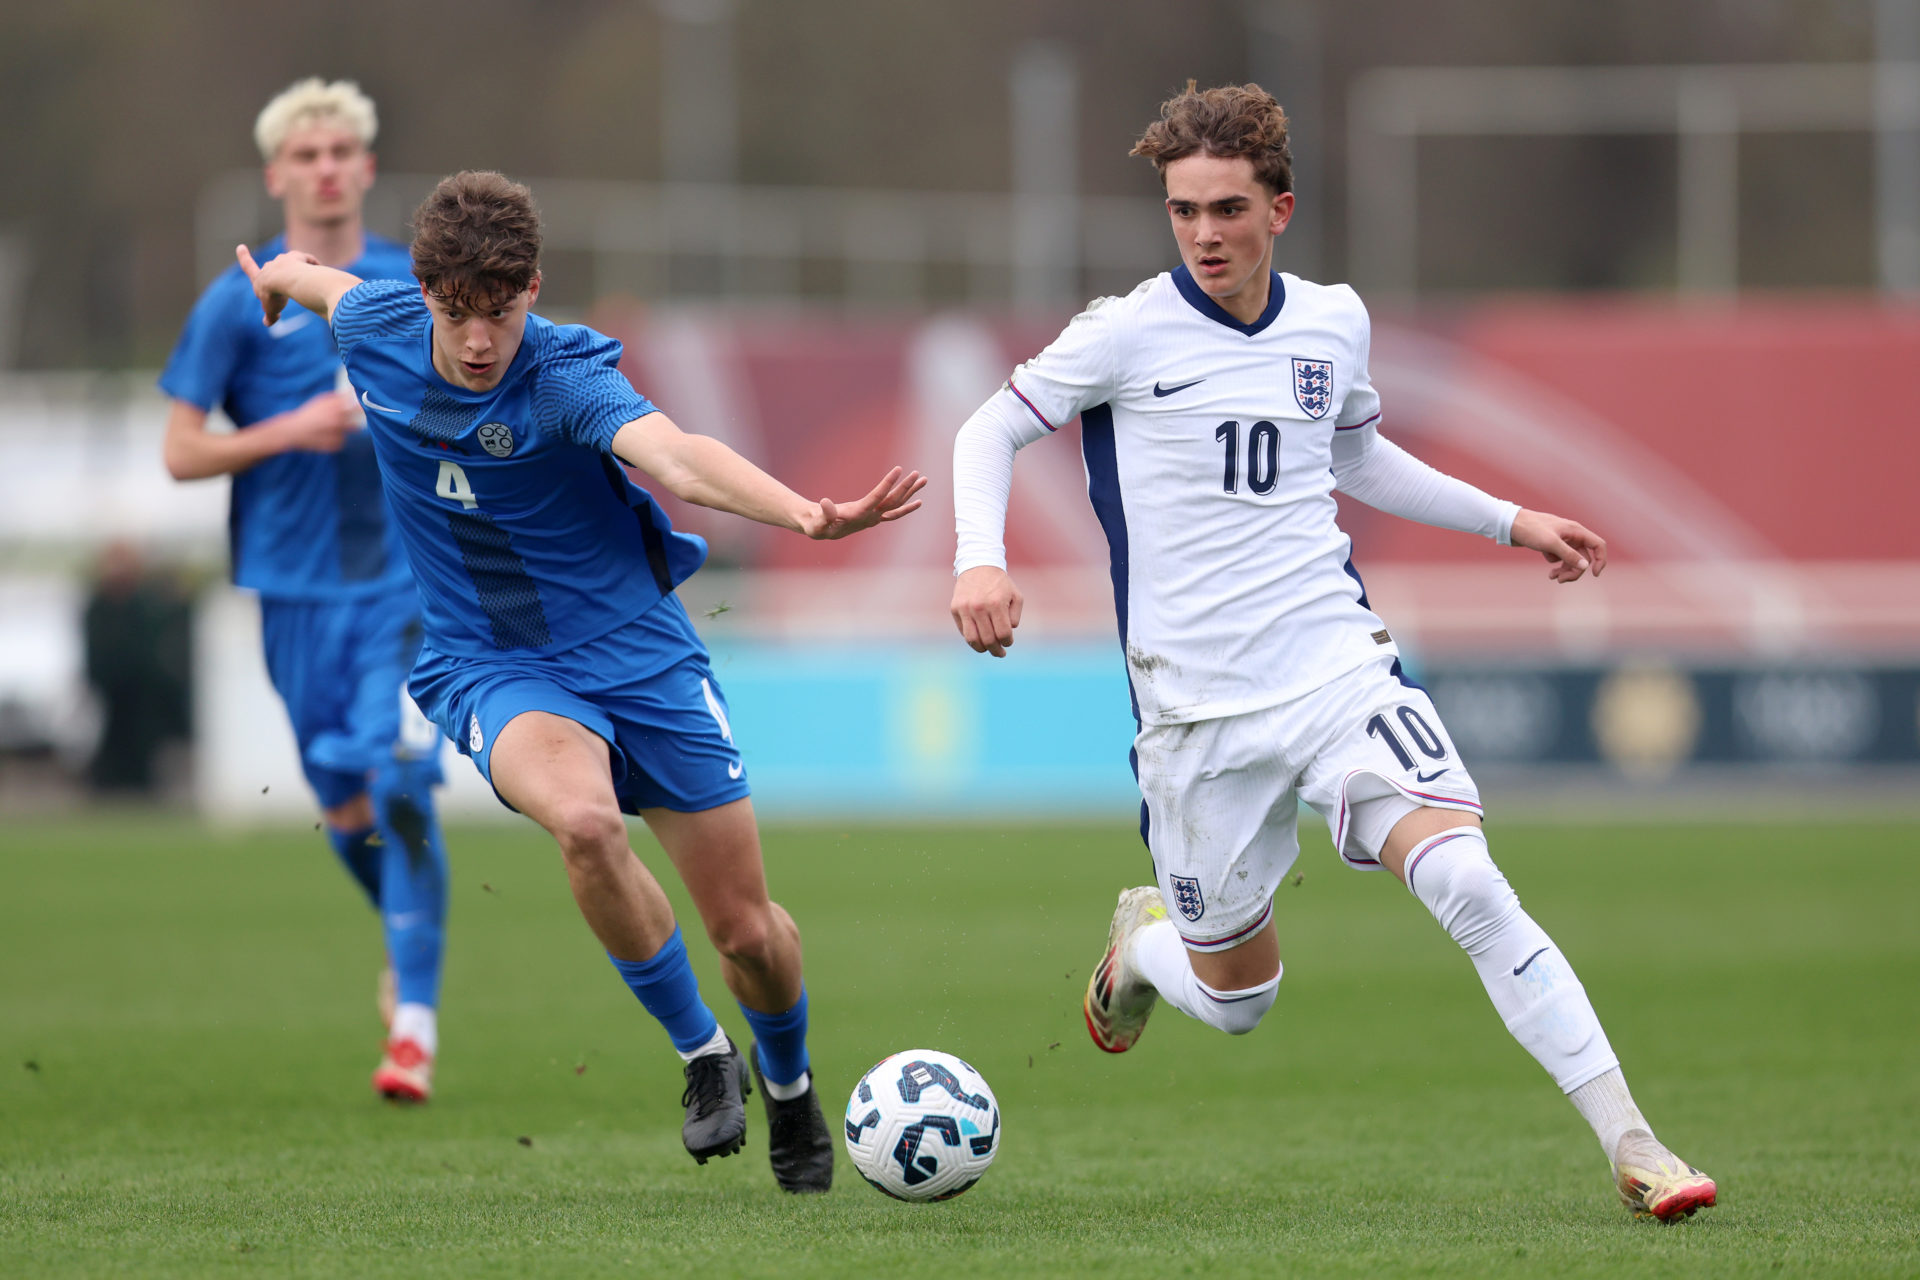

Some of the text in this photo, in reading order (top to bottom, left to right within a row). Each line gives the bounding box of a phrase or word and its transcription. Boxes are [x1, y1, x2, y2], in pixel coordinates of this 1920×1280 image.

[435, 460, 479, 510] 4
[1215, 420, 1281, 496] 10
[1365, 705, 1448, 772] 10
